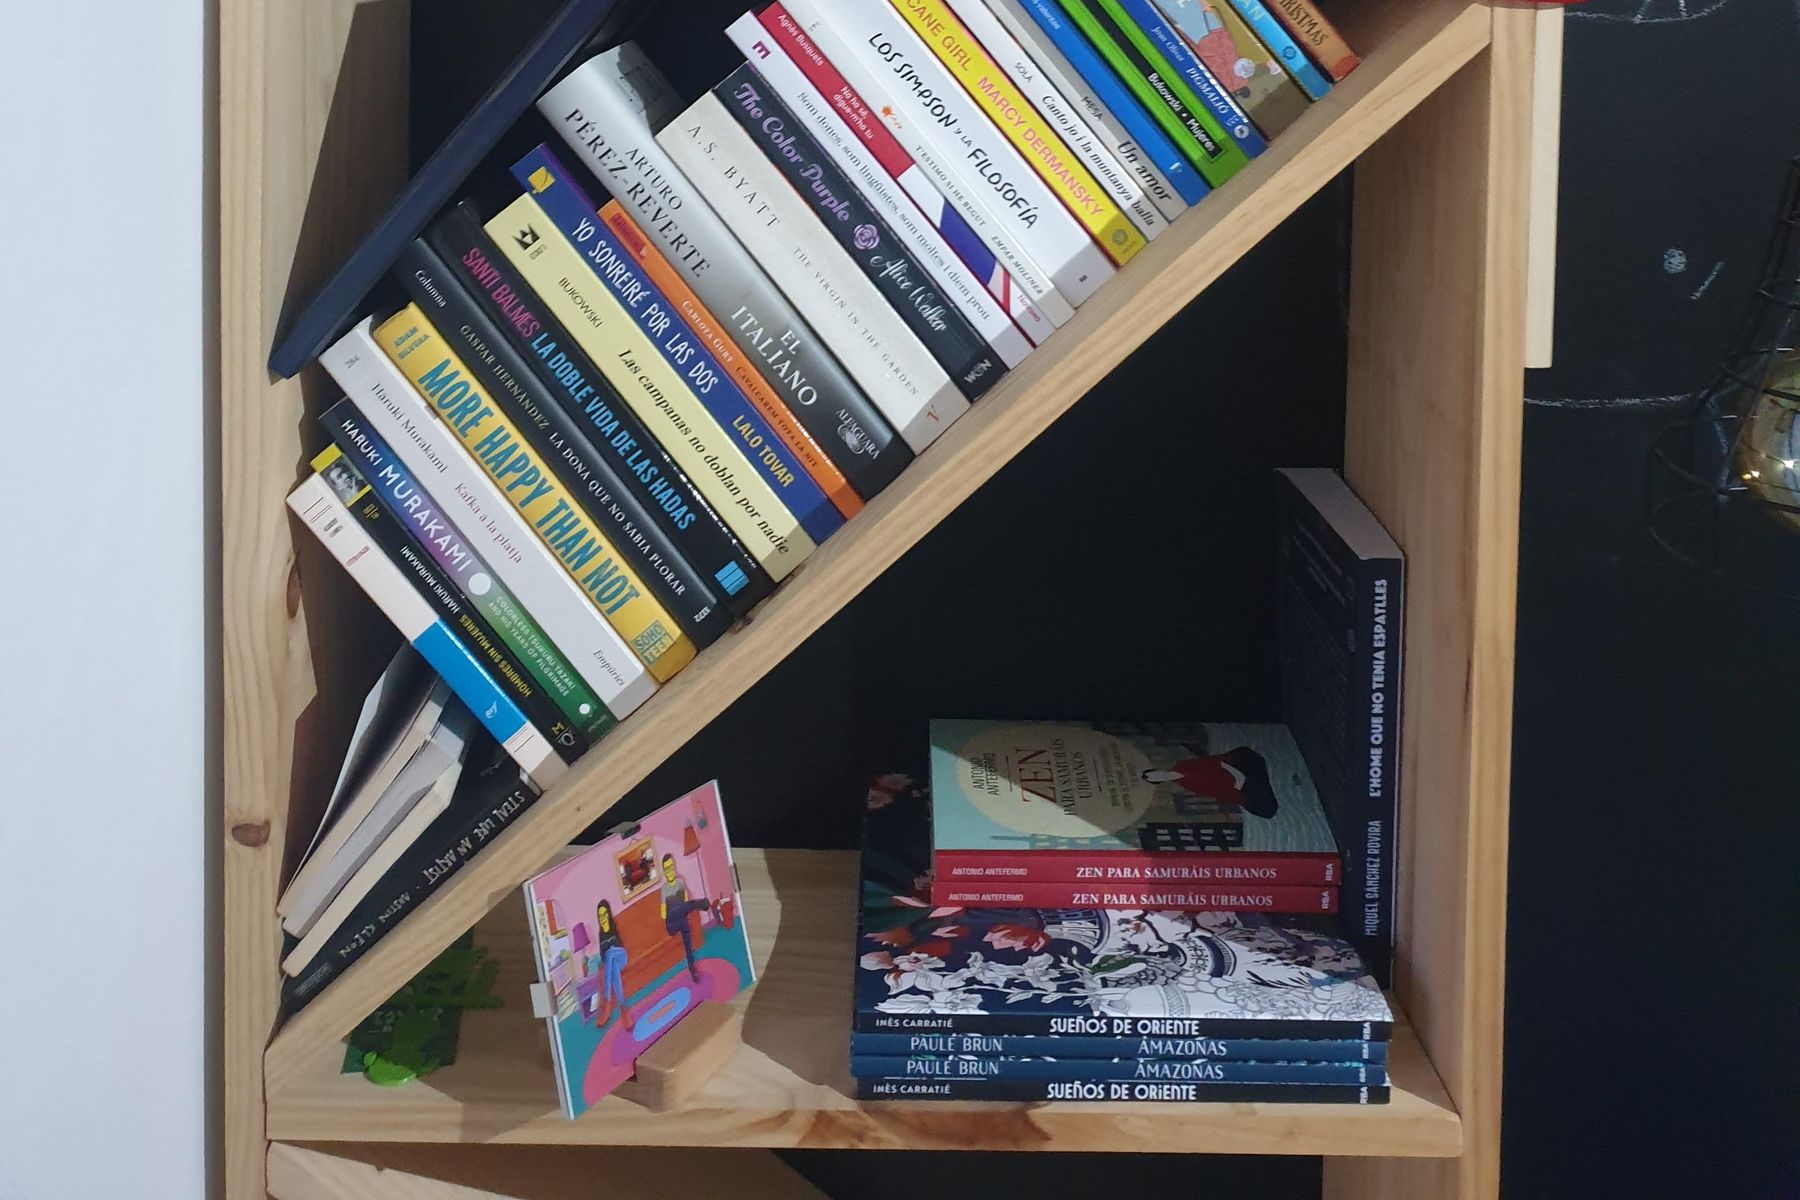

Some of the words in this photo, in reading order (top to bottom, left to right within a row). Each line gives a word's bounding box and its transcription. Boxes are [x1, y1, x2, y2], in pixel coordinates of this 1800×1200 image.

[939, 33, 975, 72] GIRL
[1040, 92, 1071, 126] Canto
[1080, 94, 1104, 122] MESA
[1185, 64, 1230, 115] PIGMALIÓ
[867, 30, 902, 67] LOS
[891, 58, 958, 131] SIMPSON
[965, 143, 1044, 229] FILOSOFÍA
[1062, 121, 1081, 139] jo
[1146, 71, 1185, 112] Bukowski
[1183, 117, 1218, 152] Mujeres
[731, 80, 770, 122] The
[758, 111, 809, 168] Color
[795, 159, 856, 226] Purple
[975, 74, 1028, 132] MARCY
[1021, 125, 1103, 219] DERMANSKY
[1075, 134, 1086, 144] i
[1079, 139, 1094, 154] la
[621, 144, 687, 212] ARTURO
[1086, 151, 1133, 204] muntanya
[1116, 138, 1141, 165] Un
[1134, 161, 1172, 204] amor
[562, 104, 715, 278] PÉREZ-REVERTE
[722, 164, 781, 230] BYATT
[1129, 198, 1156, 228] balla
[412, 268, 449, 308] Columna
[460, 245, 501, 289] SANTI
[490, 282, 541, 338] BALMES
[556, 276, 604, 329] BUKOWSKI
[568, 216, 597, 244] YO
[586, 237, 651, 309] SONREIRÉ
[639, 303, 672, 336] POR
[664, 332, 696, 365] LAS
[686, 360, 720, 395] DOS
[867, 242, 919, 297] Alice
[906, 283, 955, 335] Walker
[791, 245, 813, 269] THE
[812, 270, 847, 310] VIRGIN
[846, 311, 860, 326] IN
[860, 328, 881, 350] THE
[880, 351, 920, 396] GARDEN
[457, 322, 496, 366] GASPAR
[728, 304, 821, 410] ITALIANO
[778, 329, 804, 355] EL
[368, 382, 406, 422] Haruki
[399, 417, 450, 474] Murakami
[530, 331, 557, 359] LA
[546, 351, 593, 403] DOBLE
[581, 396, 620, 437] VIDA
[609, 429, 637, 457] DE
[624, 448, 659, 484] LAS
[646, 475, 697, 531] HADAS
[616, 347, 644, 376] Las
[635, 372, 693, 438] campanas
[687, 435, 706, 455] no
[701, 450, 745, 498] doblan
[735, 494, 761, 522] por
[755, 516, 792, 556] nadie
[731, 413, 764, 449] LALO
[756, 444, 795, 488] TOVAR
[338, 417, 384, 467] HARUKI
[376, 462, 473, 573] MURAKAMI
[414, 356, 495, 441] MORE
[468, 422, 556, 514] HAPPY
[530, 497, 606, 574] THAN
[578, 555, 642, 620] NOT
[452, 481, 484, 515] Kafka
[477, 513, 488, 524] a
[484, 519, 500, 534] la
[492, 530, 525, 565] platja
[547, 431, 565, 449] LA
[561, 447, 591, 480] DONA
[585, 478, 611, 506] QUE
[607, 503, 626, 523] NO
[621, 520, 652, 554] SABIA
[647, 552, 687, 596] PLORAR
[398, 544, 437, 587] MURAKAMI
[432, 582, 461, 614] HARUKI
[1373, 579, 1387, 647] ESPATLLES
[457, 613, 492, 650] MUJERES
[486, 646, 502, 663] SIN
[1372, 650, 1386, 689] TENIA
[497, 658, 533, 697] HOMBRES
[1371, 693, 1384, 713] NO
[1370, 716, 1383, 744] QUE
[1017, 748, 1056, 803] ZEN
[490, 789, 527, 823] STEAL
[453, 836, 474, 856] AN
[1367, 821, 1382, 854] ROVIRA
[419, 847, 460, 885] ARTIST
[1076, 867, 1103, 878] ZEN
[1107, 868, 1140, 878] PARA
[1144, 865, 1211, 879] SAMURÁIS
[1215, 868, 1277, 879] URBANOS
[1325, 864, 1334, 881] RBA
[948, 893, 978, 901] ANTONIO
[1072, 893, 1100, 904] ZEN
[1103, 894, 1136, 905] PARA
[1140, 891, 1206, 905] SAMURÁIS
[1211, 895, 1273, 906] URBANOS
[1321, 891, 1330, 909] RBA
[1364, 903, 1381, 935] MIQUEL
[911, 1037, 955, 1051] PAULE
[963, 1038, 1002, 1051] BRUN
[1114, 1019, 1132, 1034] DE
[907, 1061, 951, 1075] PAULE
[959, 1061, 999, 1075] BRUN
[1111, 1085, 1129, 1099] DE
